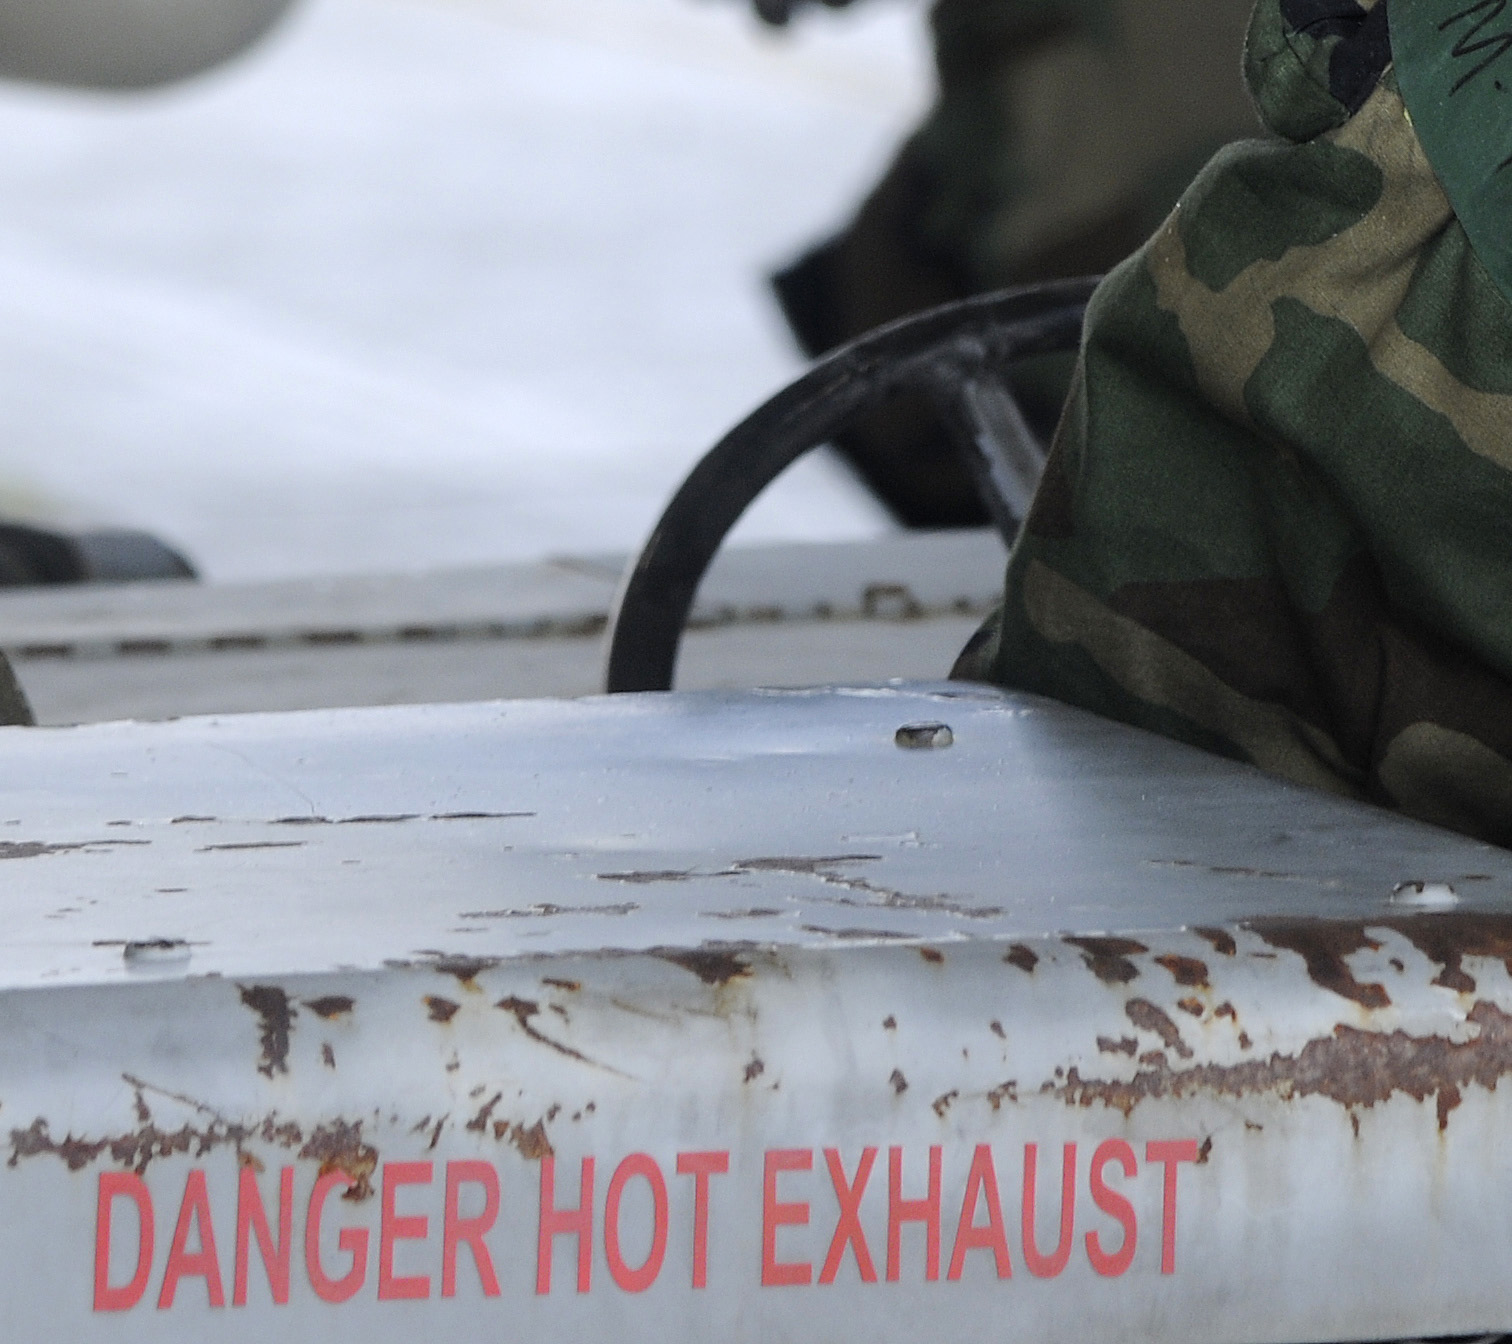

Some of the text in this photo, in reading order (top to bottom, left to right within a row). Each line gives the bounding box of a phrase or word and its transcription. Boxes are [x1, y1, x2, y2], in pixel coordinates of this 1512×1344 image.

[92, 1138, 1200, 1311] DANGER HOT EXHAUST
